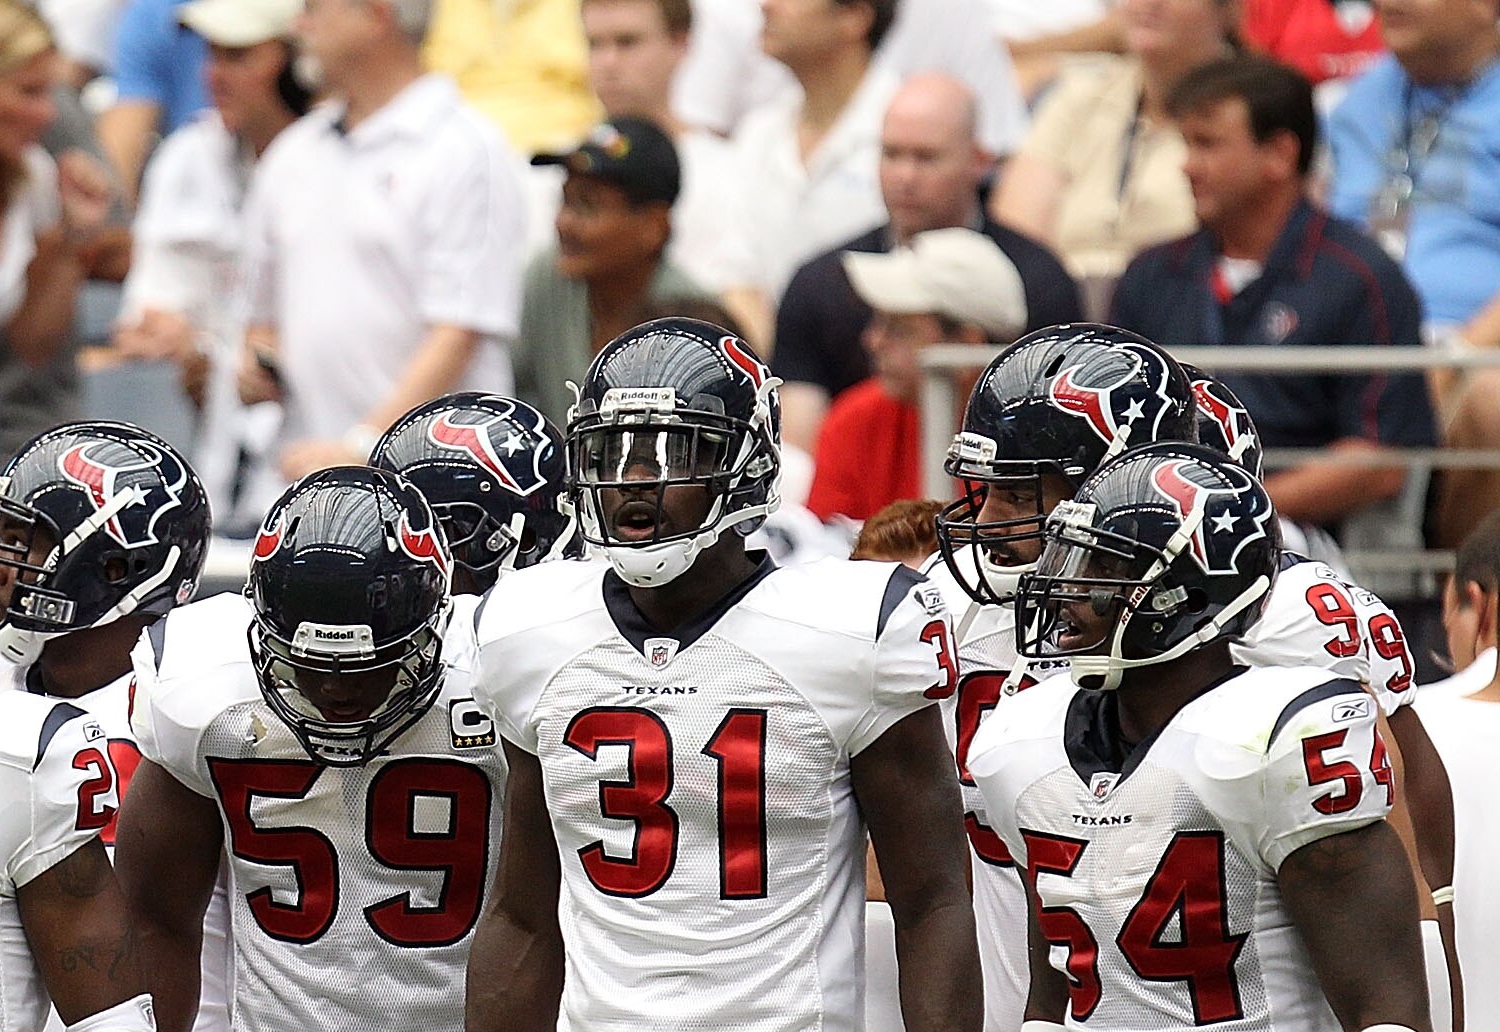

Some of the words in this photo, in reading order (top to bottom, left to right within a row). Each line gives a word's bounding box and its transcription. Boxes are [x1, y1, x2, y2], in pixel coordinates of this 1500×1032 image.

[315, 629, 354, 640] Riddell
[622, 686, 698, 695] TEXANS
[451, 700, 494, 737] C
[562, 706, 769, 900] 31
[1072, 814, 1133, 827] TEXANS
[205, 756, 492, 949] 59
[1019, 829, 1248, 1026] 54
